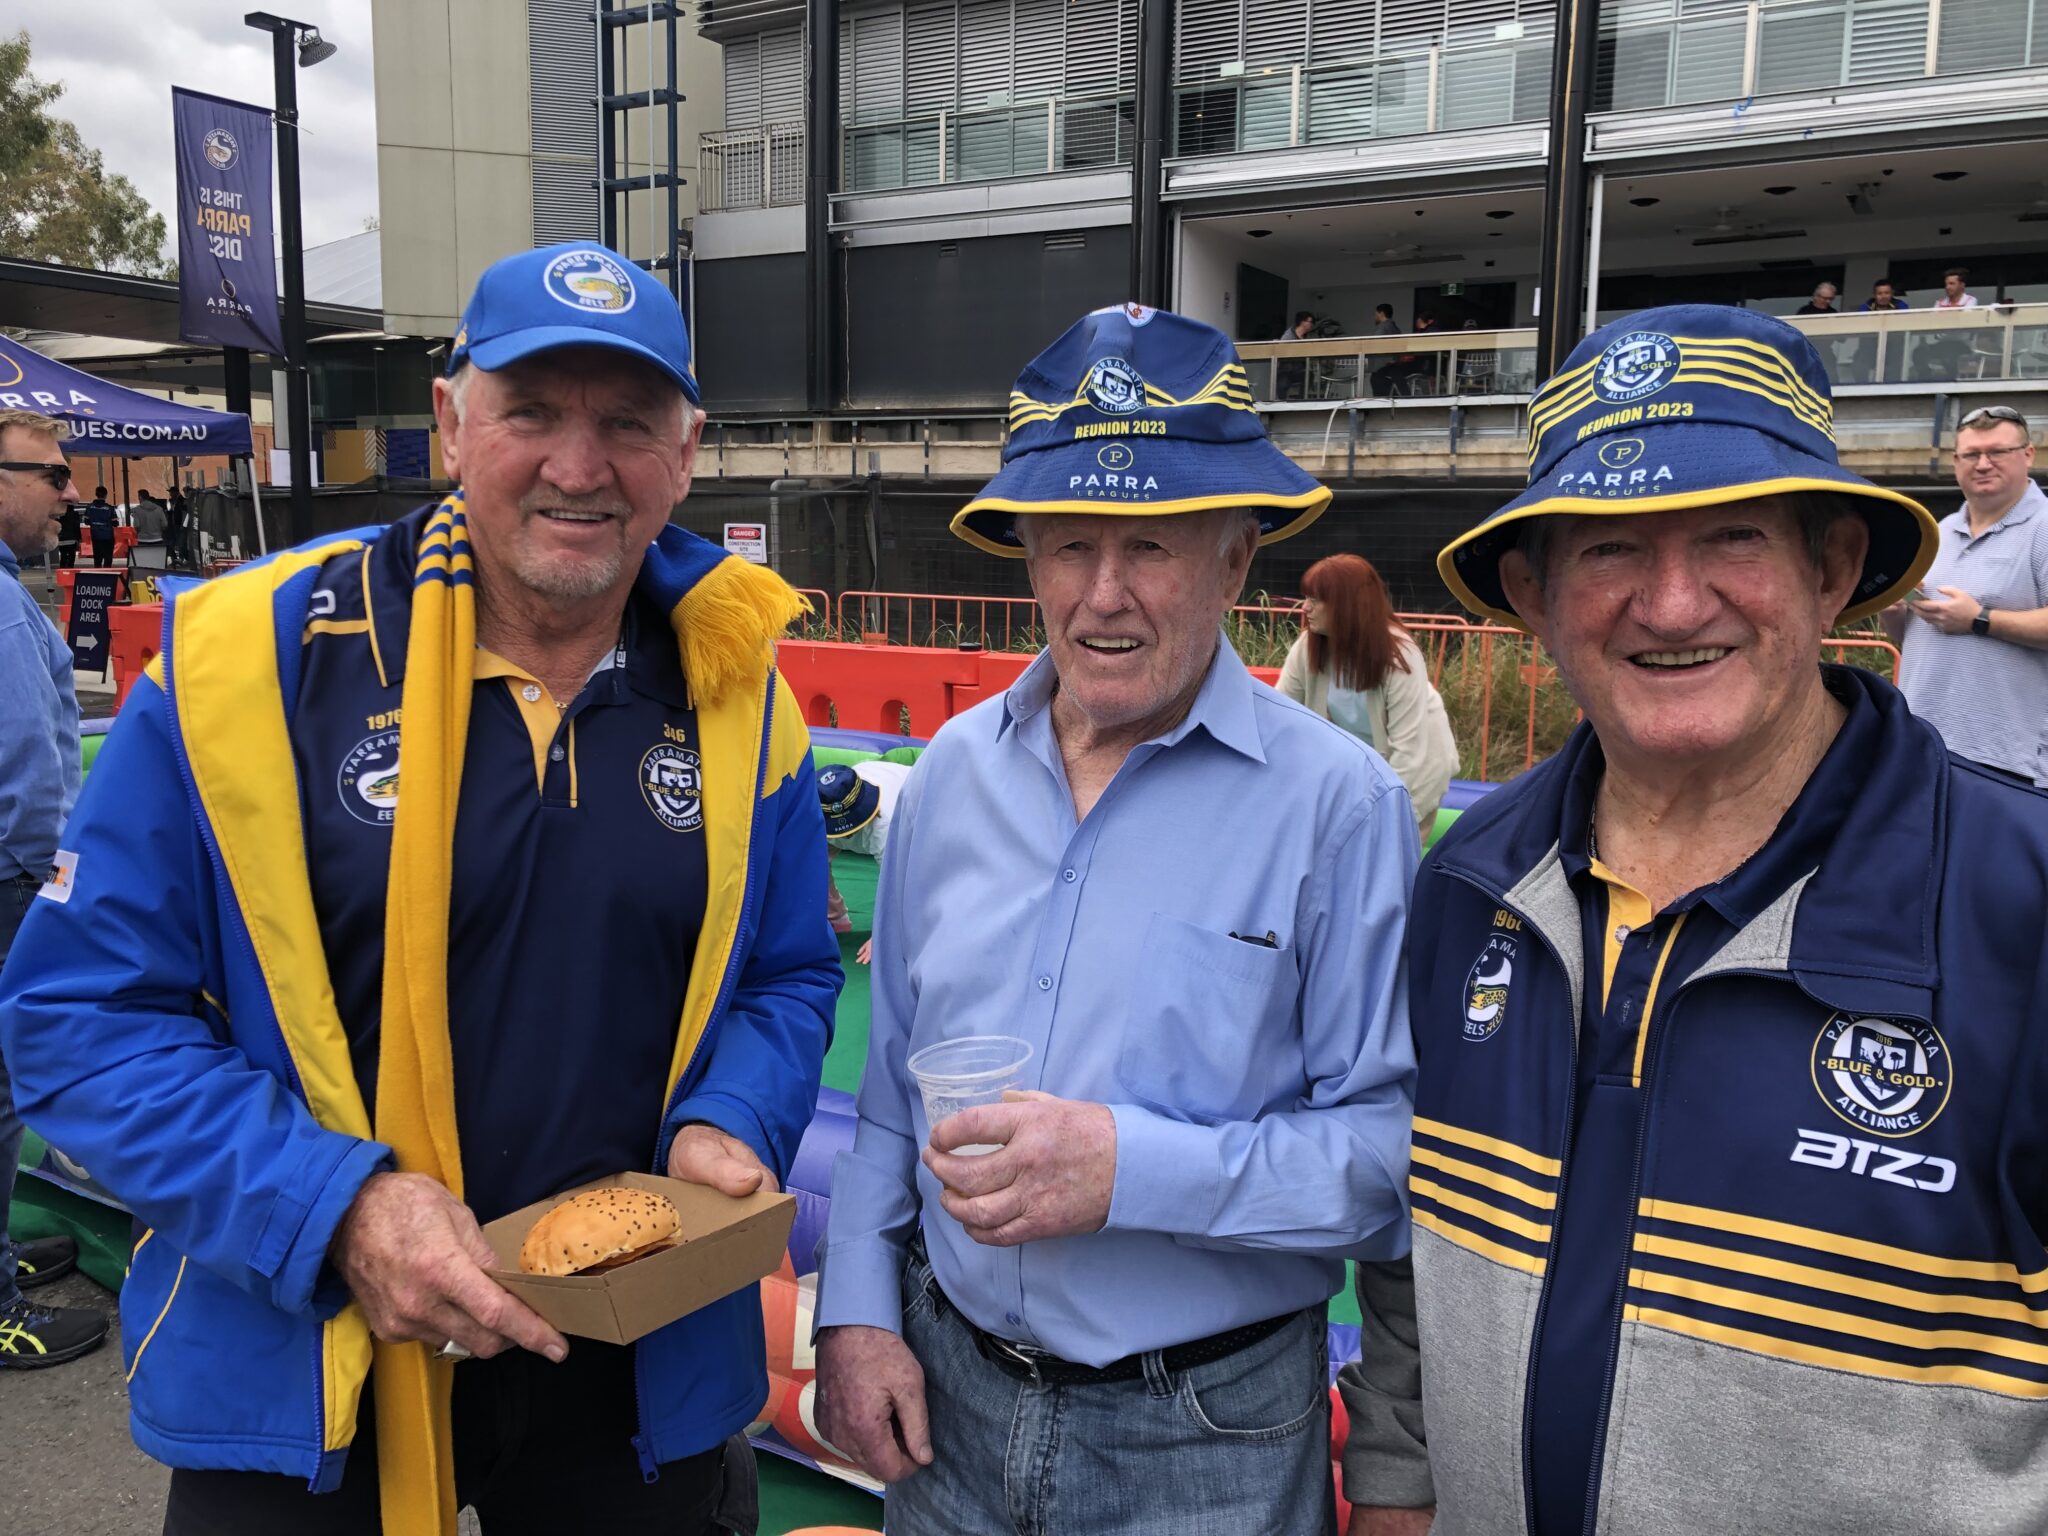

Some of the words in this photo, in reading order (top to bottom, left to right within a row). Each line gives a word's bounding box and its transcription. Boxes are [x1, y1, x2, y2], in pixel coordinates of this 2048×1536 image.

[1599, 334, 1674, 371] PARRAMATTA
[1641, 361, 1672, 371] GOLD
[1606, 380, 1662, 400] ALLIANCE
[72, 421, 207, 440] UES.COM.AU
[1075, 421, 1130, 440] REUNION
[1132, 420, 1167, 435] 2023
[1576, 406, 1643, 441] REUNION
[1646, 403, 1694, 418] 2023
[1070, 474, 1158, 490] PARRA
[1558, 465, 1673, 488] PARRA
[1565, 485, 1661, 496] LEAGUES
[76, 585, 111, 597] LOADING
[81, 599, 103, 610] DOCK
[80, 612, 101, 623] AREA
[664, 723, 685, 743] 346
[345, 735, 401, 774] PARRAM
[648, 783, 671, 796] BLUE
[674, 788, 681, 796] &
[685, 789, 700, 798] GO
[377, 810, 399, 822] EE
[656, 808, 703, 827] ALLIANCE
[1875, 1033, 1893, 1047] 2016
[1827, 1058, 1872, 1076] BLUE
[1876, 1068, 1885, 1081] &
[1890, 1073, 1936, 1088] GOLD
[1836, 1096, 1921, 1130] ALLIANCE
